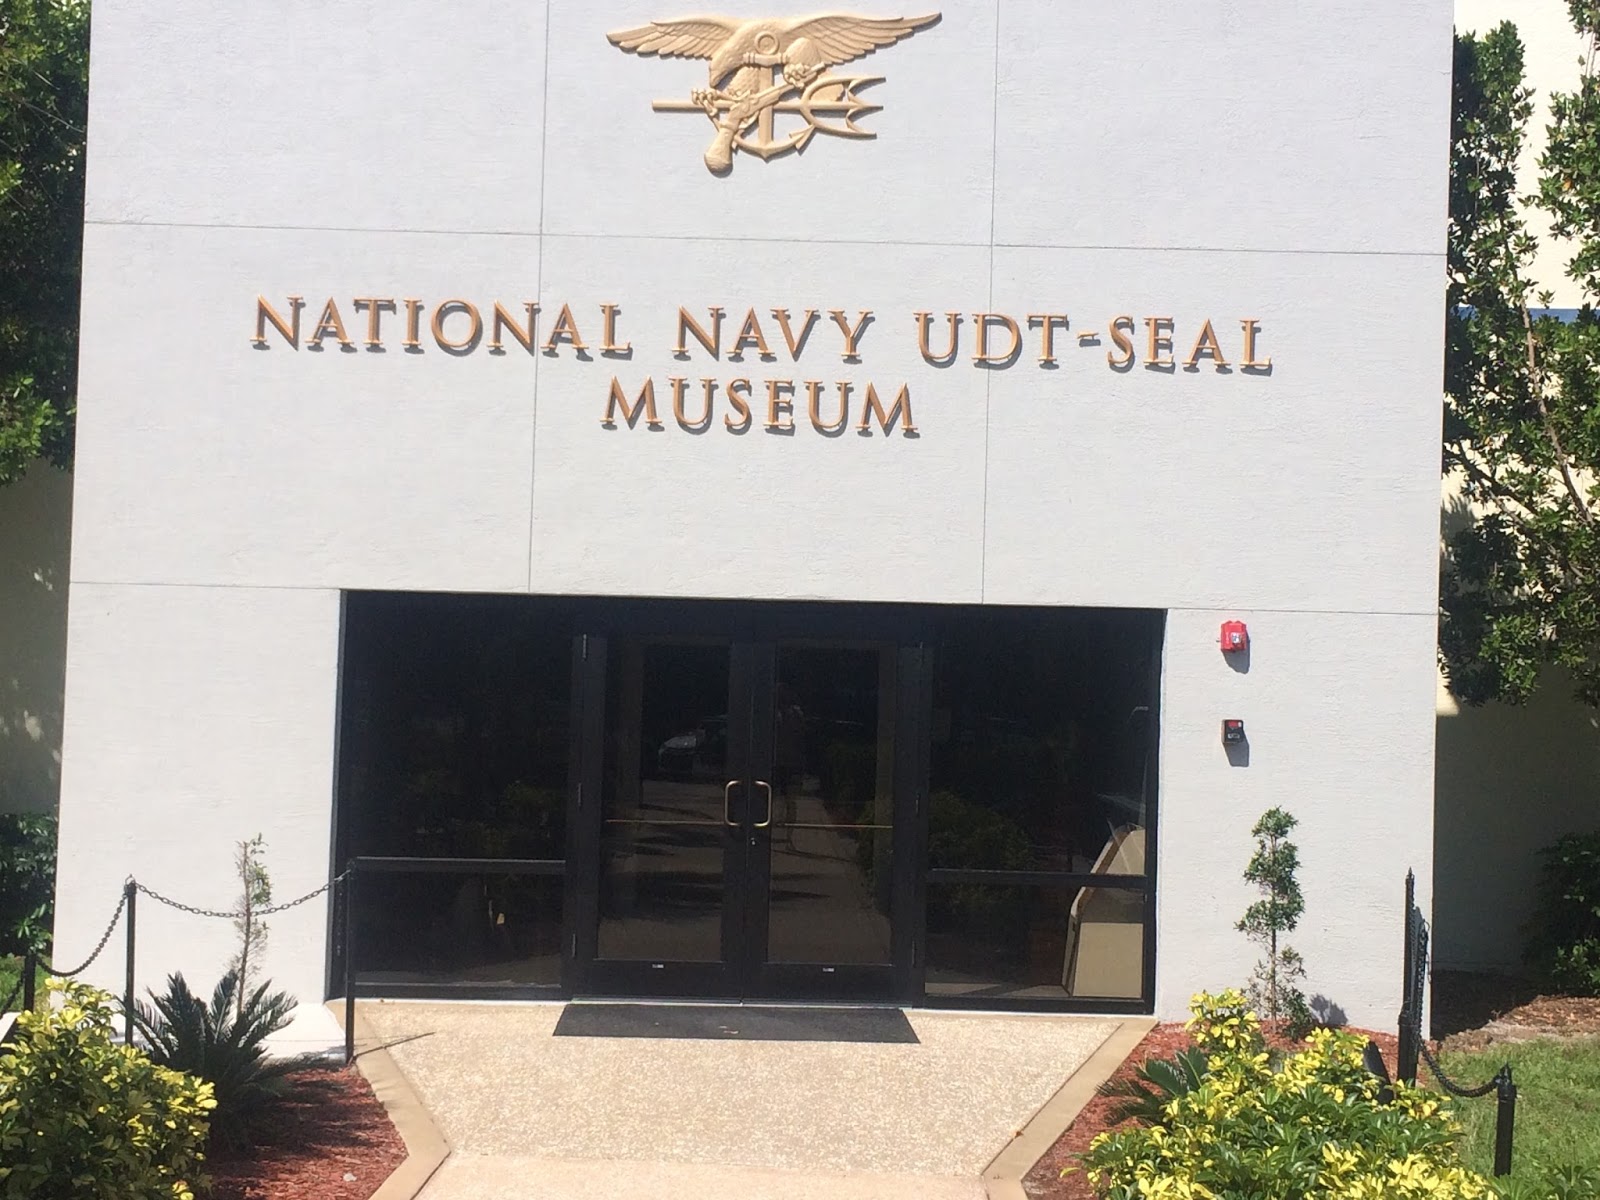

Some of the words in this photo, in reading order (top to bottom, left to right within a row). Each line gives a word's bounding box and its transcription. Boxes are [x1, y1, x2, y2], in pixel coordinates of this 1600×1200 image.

[250, 294, 632, 354] NATIONAL
[672, 304, 875, 361] NAVY
[913, 311, 1272, 371] UDT-SEAL
[600, 375, 919, 435] MUSEUM
